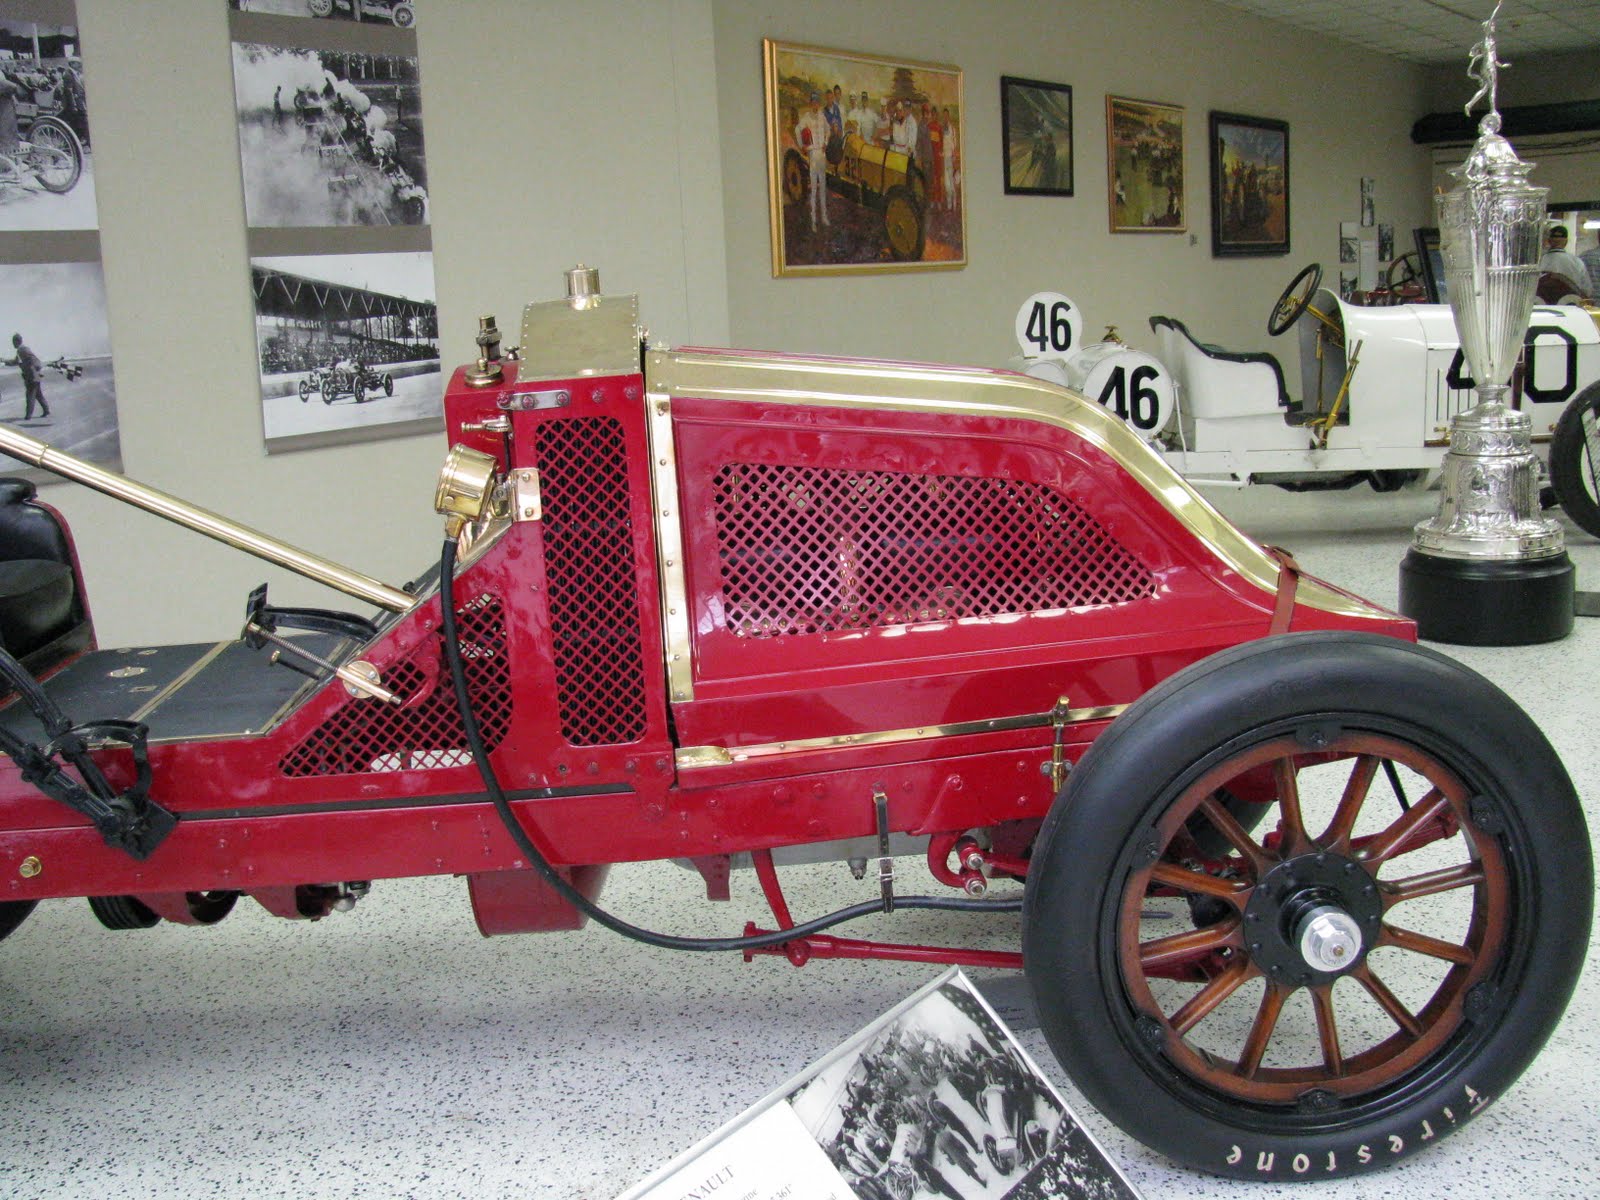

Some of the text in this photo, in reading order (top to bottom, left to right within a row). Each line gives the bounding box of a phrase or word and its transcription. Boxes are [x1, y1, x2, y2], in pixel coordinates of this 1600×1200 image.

[1025, 301, 1072, 352] 46
[1097, 365, 1160, 430] 46
[1226, 1084, 1489, 1173] Firestone
